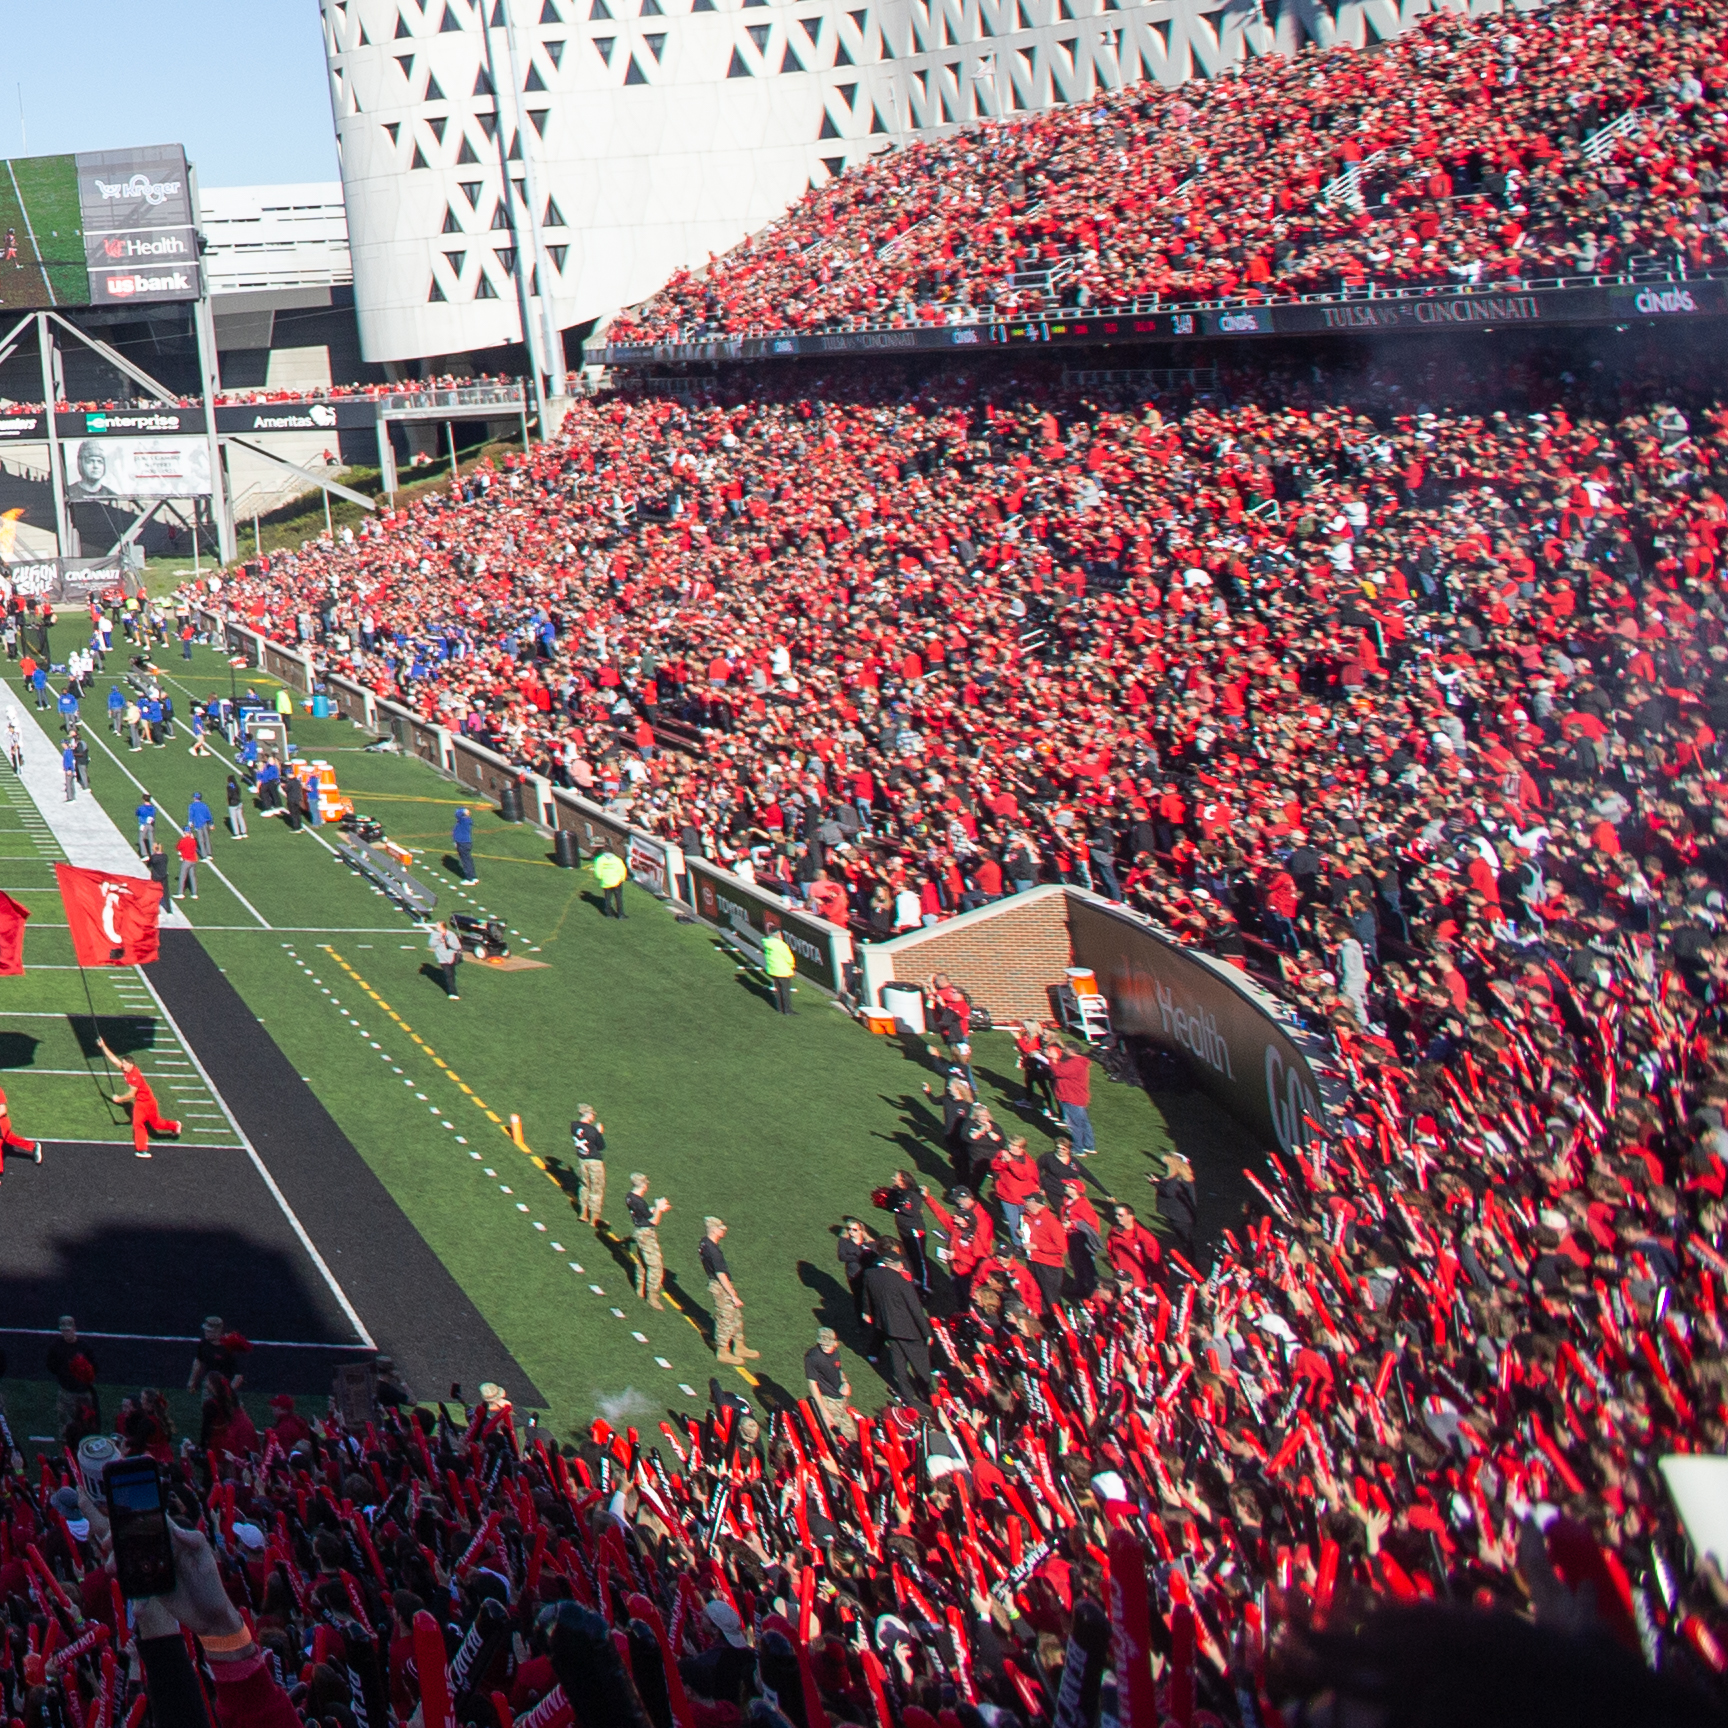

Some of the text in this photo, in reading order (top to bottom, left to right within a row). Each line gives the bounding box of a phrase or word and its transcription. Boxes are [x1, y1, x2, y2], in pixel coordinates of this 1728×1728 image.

[122, 174, 181, 205] Kroger
[1321, 307, 1376, 328] TULSA
[1415, 296, 1540, 324] CINCINNATI
[87, 413, 180, 428] enterprise
[254, 414, 312, 430] Ameritas
[65, 568, 121, 581] CINCINNATI
[1155, 980, 1237, 1083] Health
